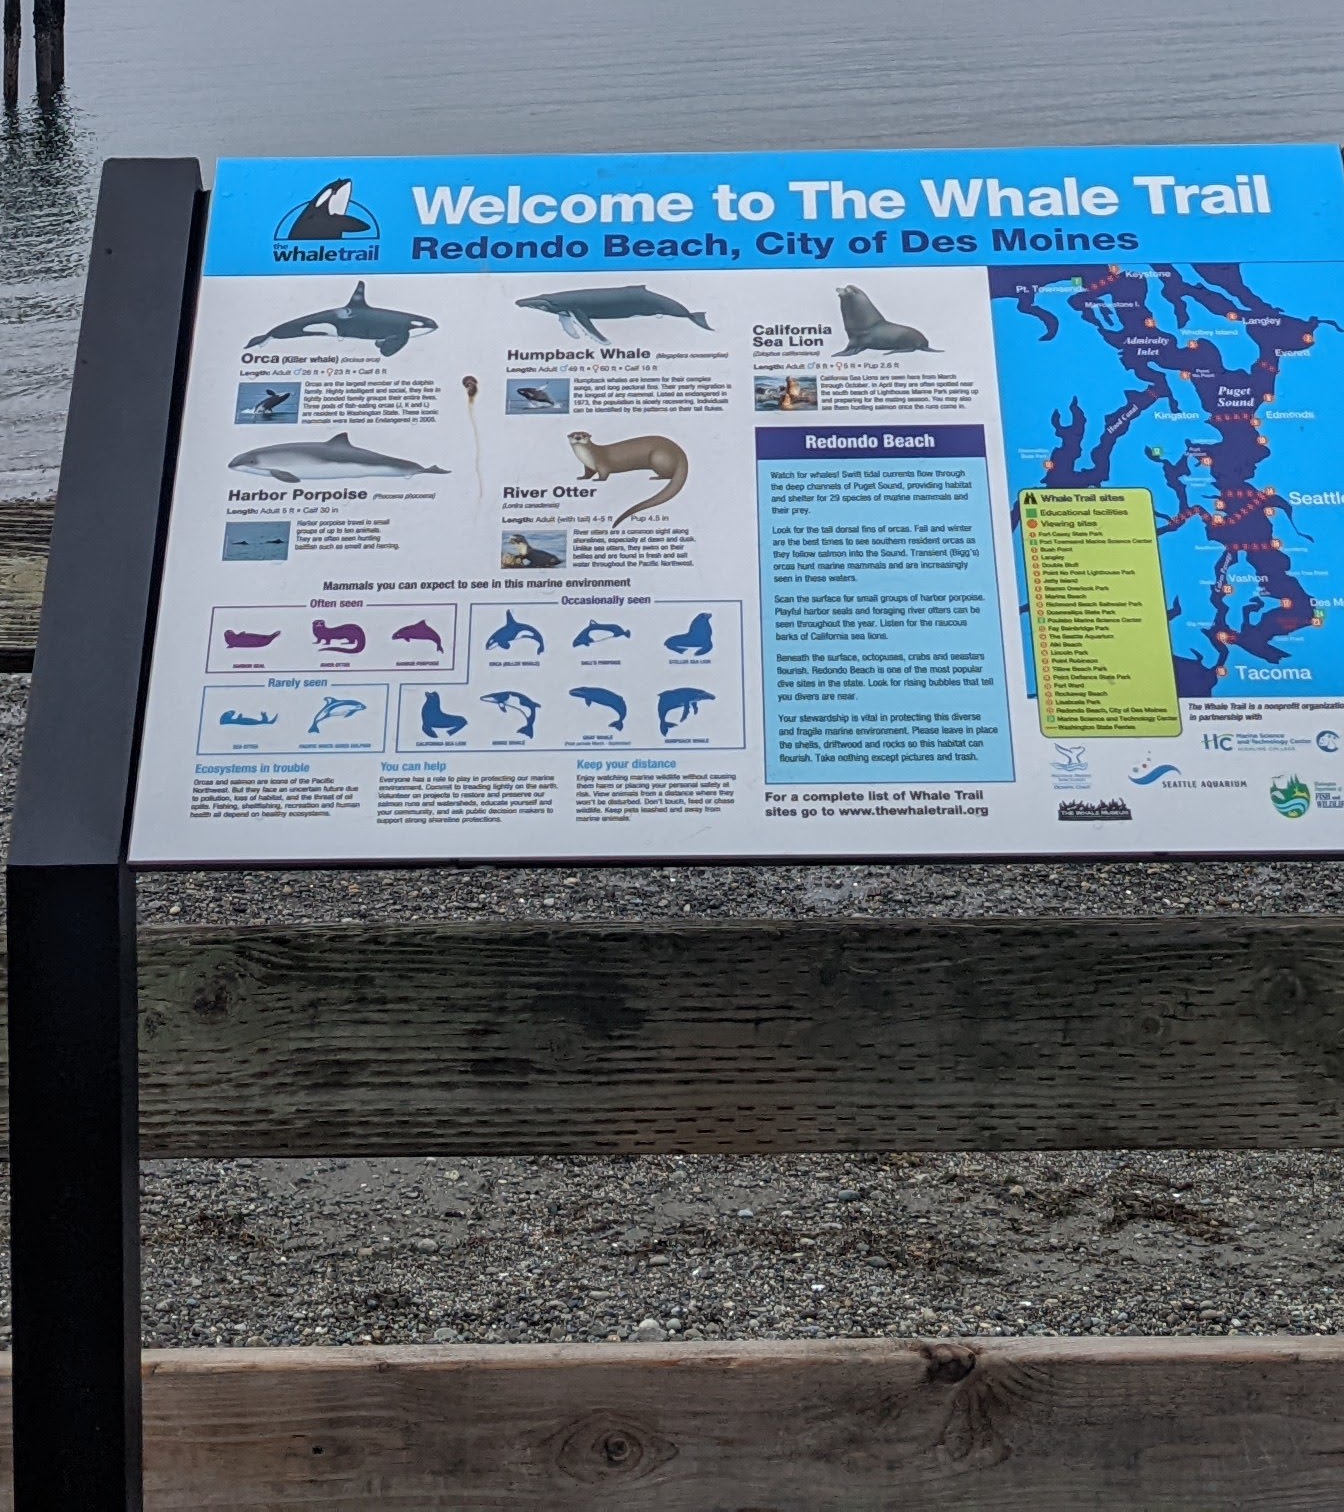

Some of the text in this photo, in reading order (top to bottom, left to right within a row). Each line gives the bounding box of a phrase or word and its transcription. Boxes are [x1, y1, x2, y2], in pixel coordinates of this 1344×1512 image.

[412, 173, 1271, 225] Welcome to The Whale Trail
[273, 243, 288, 251] the
[412, 226, 1138, 260] Redondo Beach, City of Des Moines
[1125, 268, 1171, 279] Keystone
[1242, 316, 1281, 328] Langley
[752, 323, 832, 336] California
[752, 335, 824, 348] Sea Lion
[1124, 335, 1169, 347] Admiralty
[241, 351, 279, 364] Orca
[282, 355, 306, 364] (Killer
[310, 355, 342, 364] whale)
[507, 348, 593, 360] Humpback
[600, 347, 650, 359] Whale
[1137, 347, 1160, 358] Inlet
[1218, 385, 1251, 400] Puget
[1217, 396, 1255, 409] Sound
[1154, 410, 1200, 423] Kingston
[1265, 409, 1315, 420] Edmonds
[805, 433, 934, 448] Redondo Beach
[770, 471, 794, 479] Watch
[796, 470, 807, 478] for
[916, 469, 933, 477] flow
[935, 469, 965, 478] through
[228, 488, 285, 501] Harbor
[292, 487, 367, 501] Porpoise
[503, 485, 596, 498] River Otter
[1040, 494, 1072, 502] Whale
[1074, 493, 1096, 501] Trail
[1039, 508, 1090, 516] Educational
[1040, 520, 1074, 528] Viewing
[1228, 572, 1268, 583] Vashon
[323, 578, 630, 591] Mammals you can expect to see in this marine environment
[309, 598, 336, 608] Often
[561, 595, 651, 605] Occasionally seen
[1309, 597, 1330, 607] Des
[1236, 666, 1311, 680] Tacoma
[267, 676, 327, 689] Rarely seen
[1188, 702, 1202, 710] The
[1204, 702, 1228, 710] Whale
[1230, 702, 1246, 710] Trail
[1248, 702, 1255, 710] is
[1264, 702, 1299, 710] nonprofit
[778, 712, 981, 723] Your stewardship is vital in protecting this diverse
[1198, 713, 1243, 721] partnership
[816, 753, 835, 762] Take
[837, 753, 869, 763] nothing
[871, 753, 898, 762] except
[901, 752, 934, 762] pictures
[937, 752, 952, 761] and
[954, 752, 978, 760] trash.
[194, 762, 309, 775] Ecosystems in trouble
[380, 761, 446, 772] You can help
[576, 758, 676, 771] Keep your distance
[1162, 780, 1247, 788] SEATTLE AQUARIUM
[764, 789, 983, 802] For a complete list of Whale Trail
[765, 805, 988, 818] sites go to www.thewhaletrail.org
[1060, 809, 1075, 817] THE
